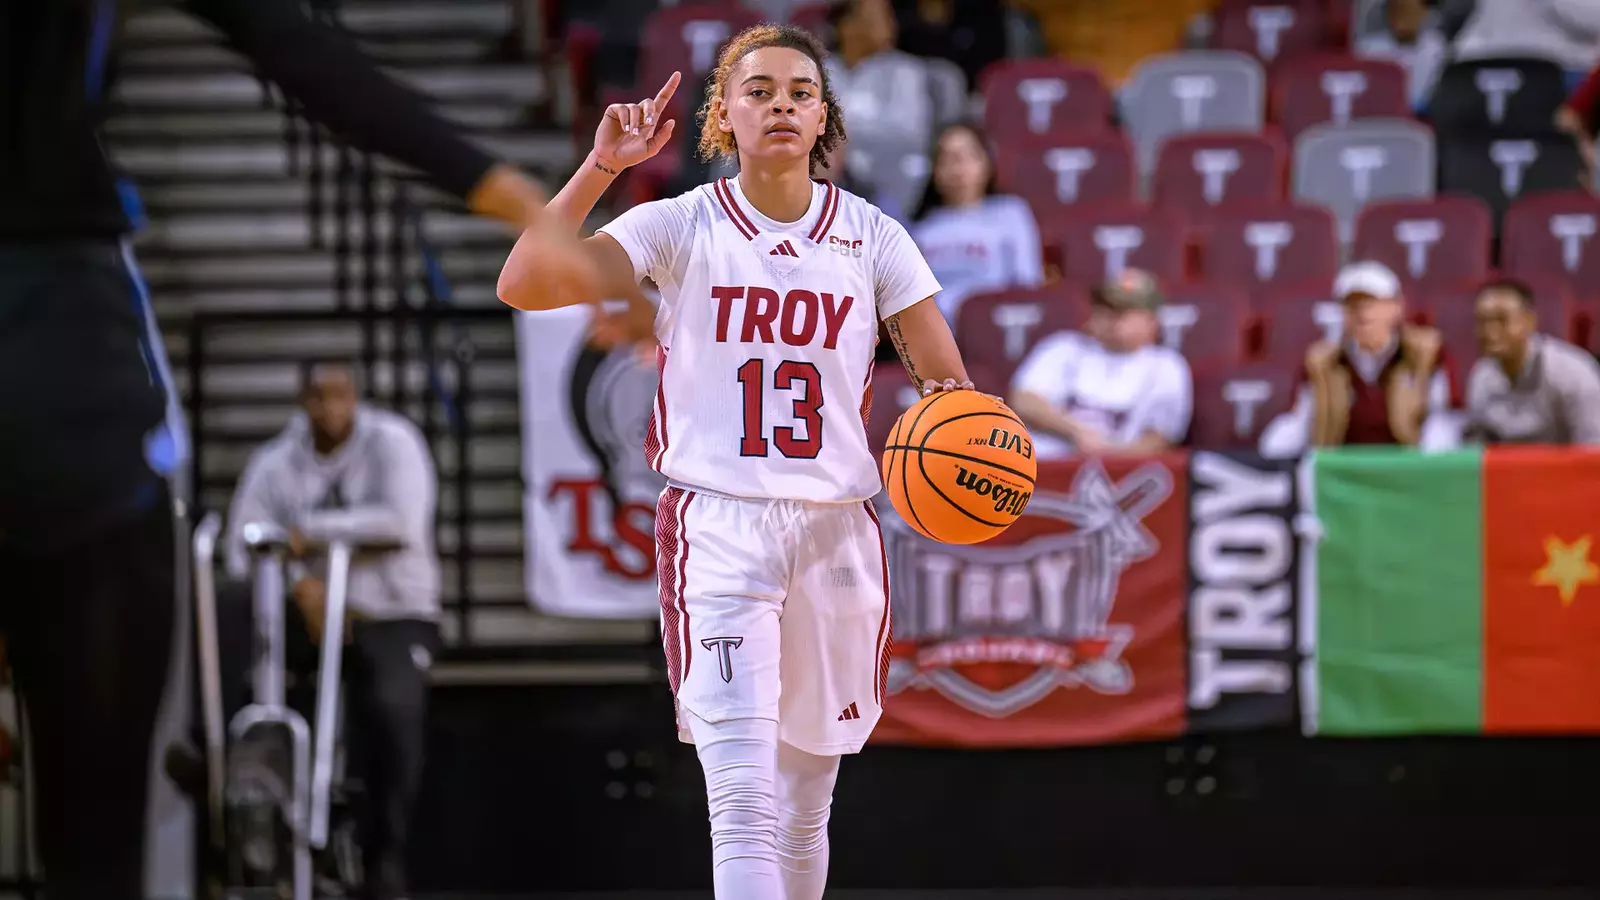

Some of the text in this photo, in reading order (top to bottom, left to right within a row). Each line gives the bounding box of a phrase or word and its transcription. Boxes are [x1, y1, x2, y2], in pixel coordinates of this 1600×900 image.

[711, 286, 854, 350] TROY
[737, 358, 824, 459] 13
[966, 427, 1032, 460] EVO NXT
[955, 467, 1031, 516] Wilson
[1189, 451, 1293, 709] TROY
[701, 637, 743, 684] T
